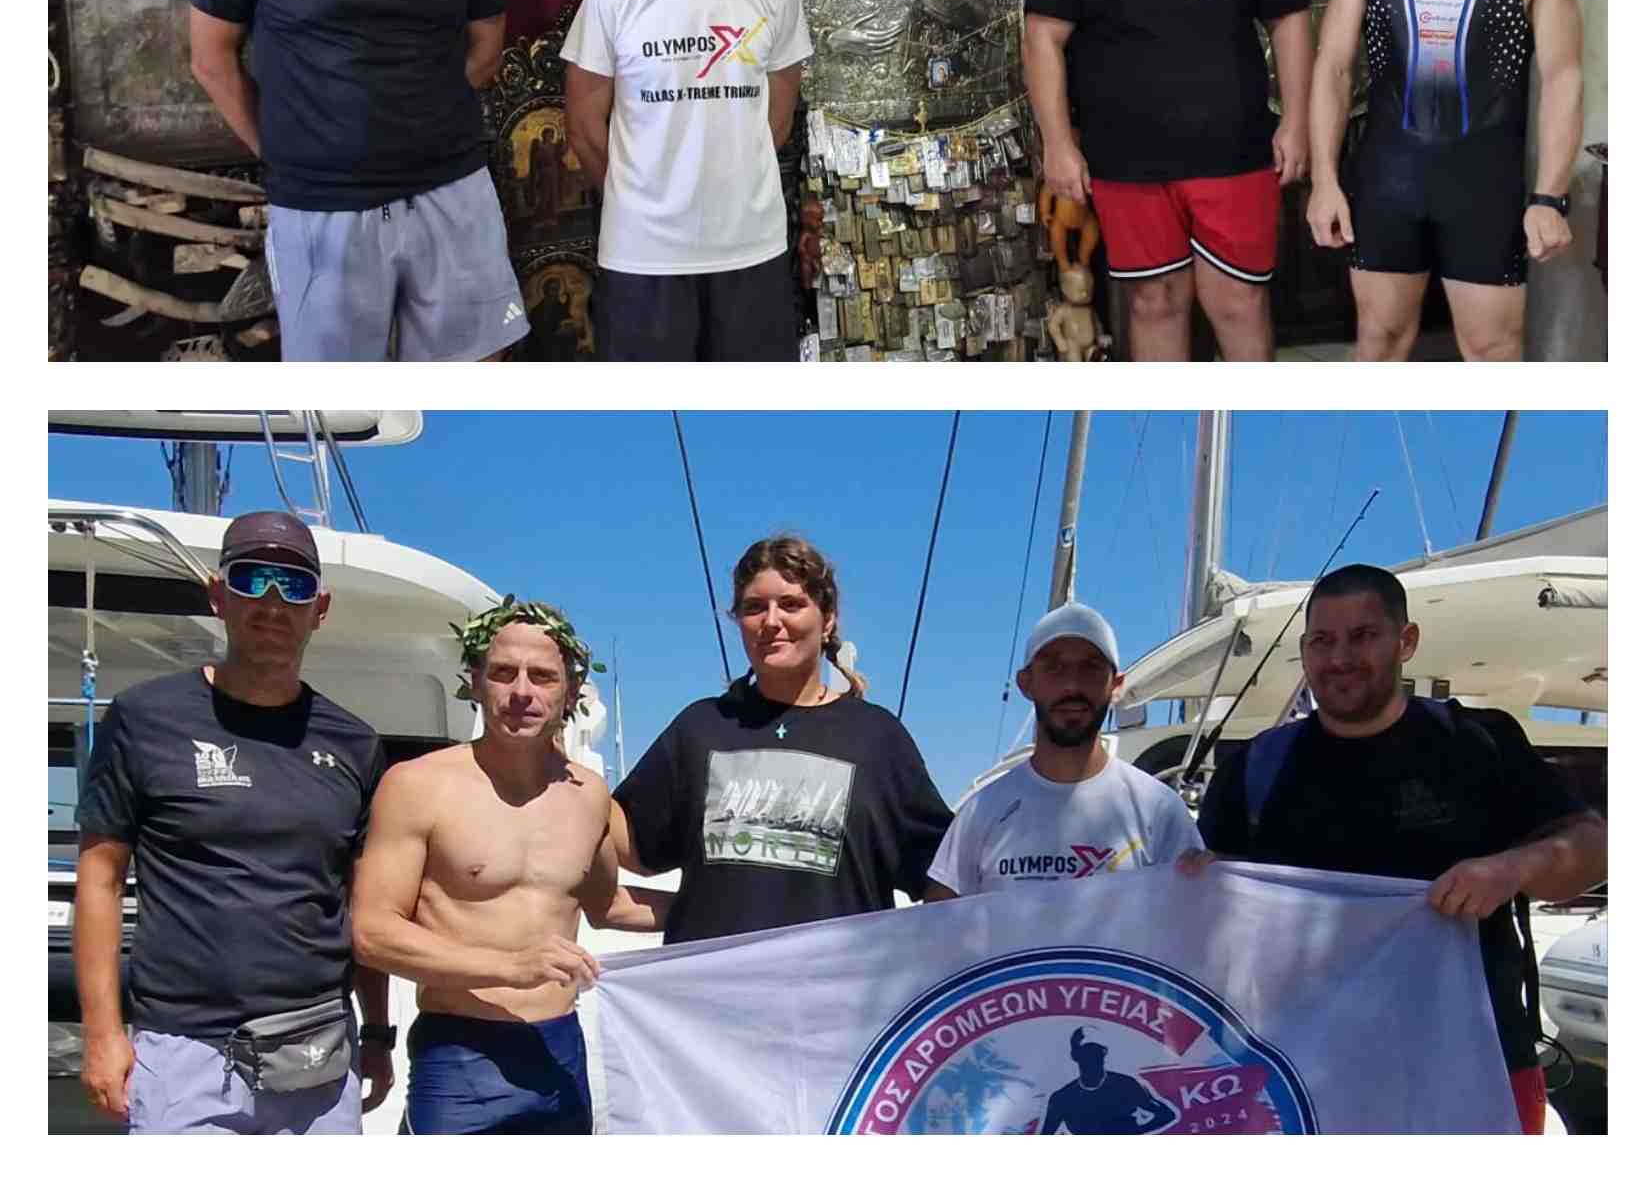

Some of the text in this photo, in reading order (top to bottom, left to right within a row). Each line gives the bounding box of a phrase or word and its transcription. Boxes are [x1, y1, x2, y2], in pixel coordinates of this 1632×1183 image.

[642, 36, 716, 58] OLYMPOS
[640, 88, 675, 103] HELLAS
[705, 831, 834, 867] NORTH
[1000, 856, 1078, 875] OLYMPOS
[904, 986, 1049, 1084] ΔΡΟΜΕΩΝ
[1057, 985, 1174, 1035] ΥΓΕΙΑΣ
[1179, 1074, 1243, 1110] ΚΩ
[1189, 1108, 1248, 1133] 2024
